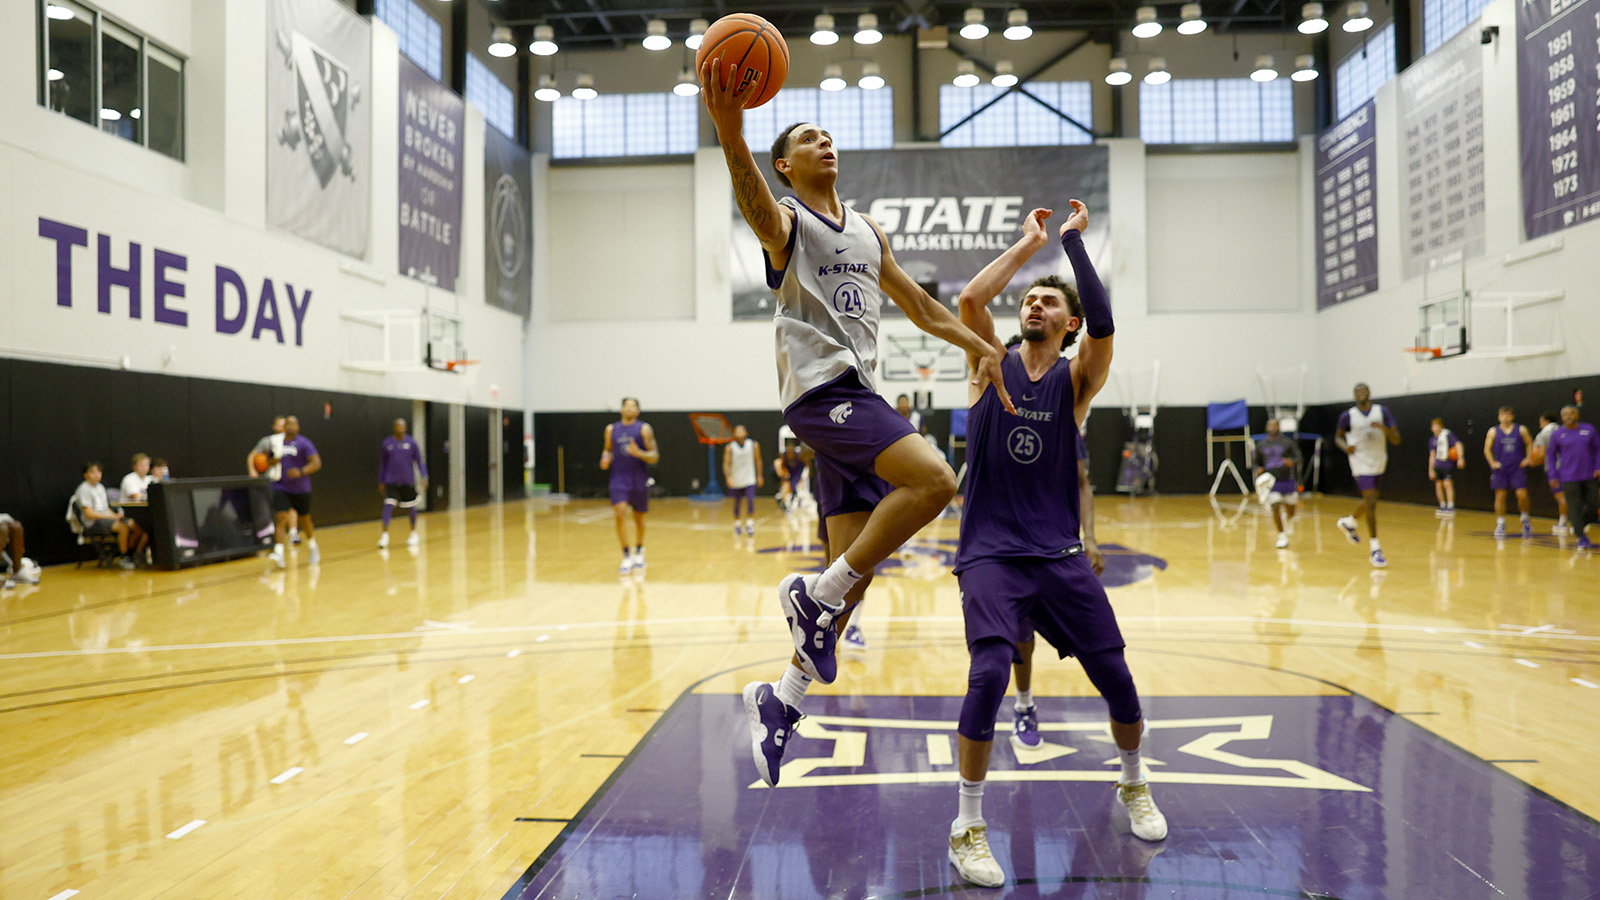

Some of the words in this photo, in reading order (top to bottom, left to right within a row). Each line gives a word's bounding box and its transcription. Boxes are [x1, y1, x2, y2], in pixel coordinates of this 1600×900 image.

[1547, 29, 1572, 57] 1951
[1548, 53, 1575, 81] 1958
[1548, 78, 1575, 105] 1959
[405, 90, 457, 146] NEVER
[1550, 101, 1575, 128] 1961
[404, 123, 455, 173] BROKEN
[1549, 125, 1577, 152] 1964
[1551, 149, 1578, 175] 1972
[1553, 173, 1578, 199] 1973
[401, 202, 452, 245] BATTLE
[845, 197, 1024, 233] STATE
[892, 234, 1008, 251] BASKETBALL
[38, 217, 189, 328] THE
[215, 264, 313, 347] DAY
[818, 263, 868, 276] K-STATE
[841, 289, 862, 312] 24
[1007, 407, 1053, 421] STATE
[1014, 432, 1035, 456] 25
